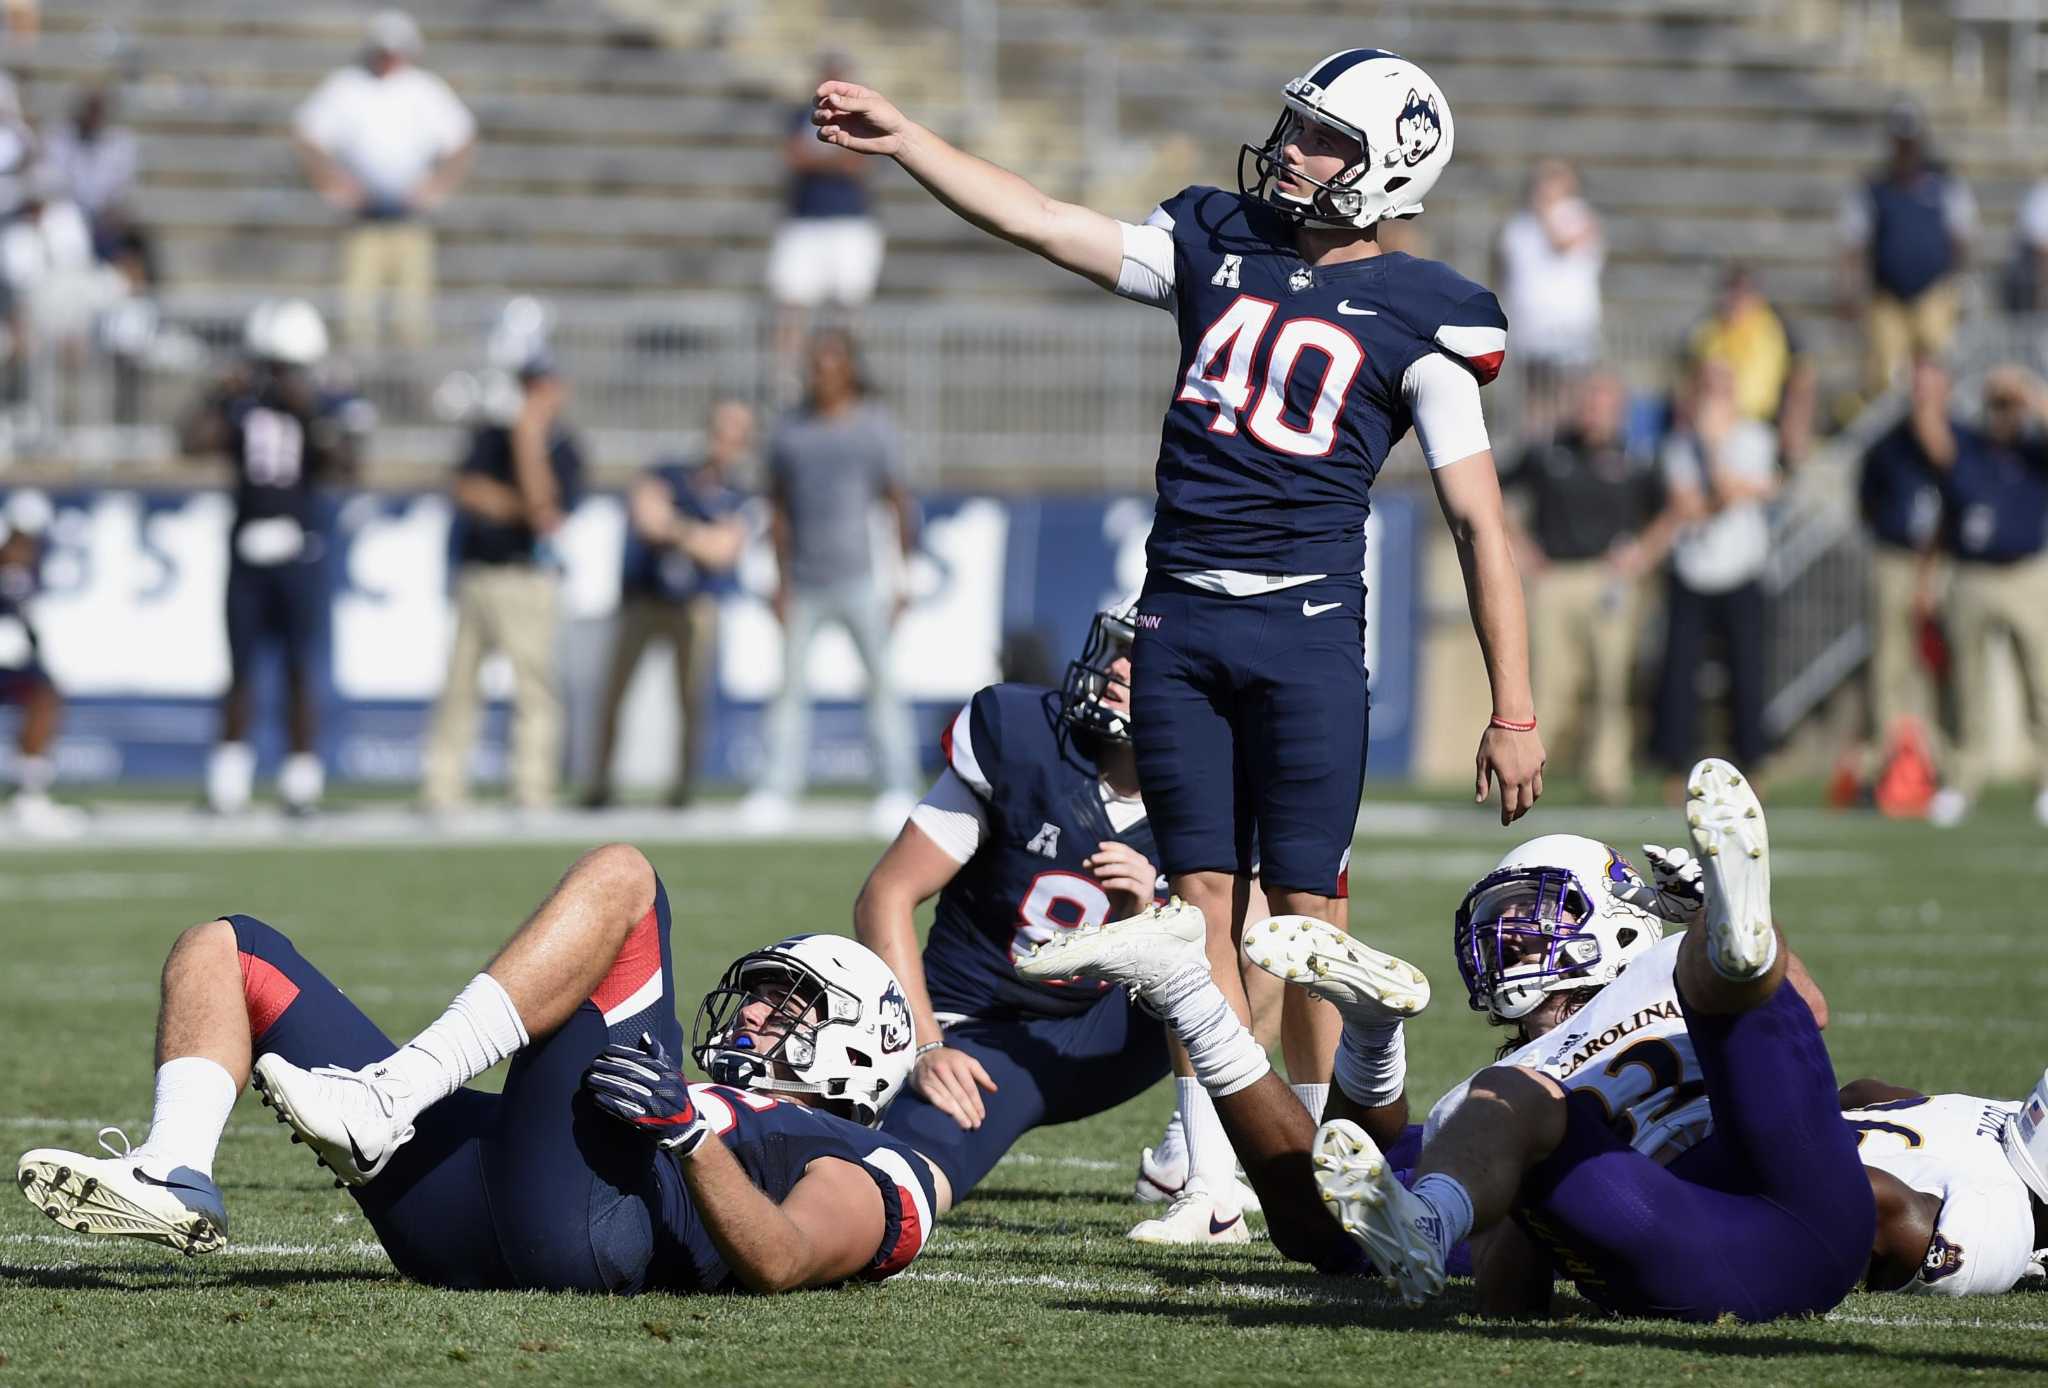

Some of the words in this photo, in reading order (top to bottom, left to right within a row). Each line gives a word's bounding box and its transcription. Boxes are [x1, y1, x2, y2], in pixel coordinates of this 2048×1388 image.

[1211, 253, 1243, 289] A
[1176, 293, 1366, 458] 40
[1026, 822, 1061, 860] A
